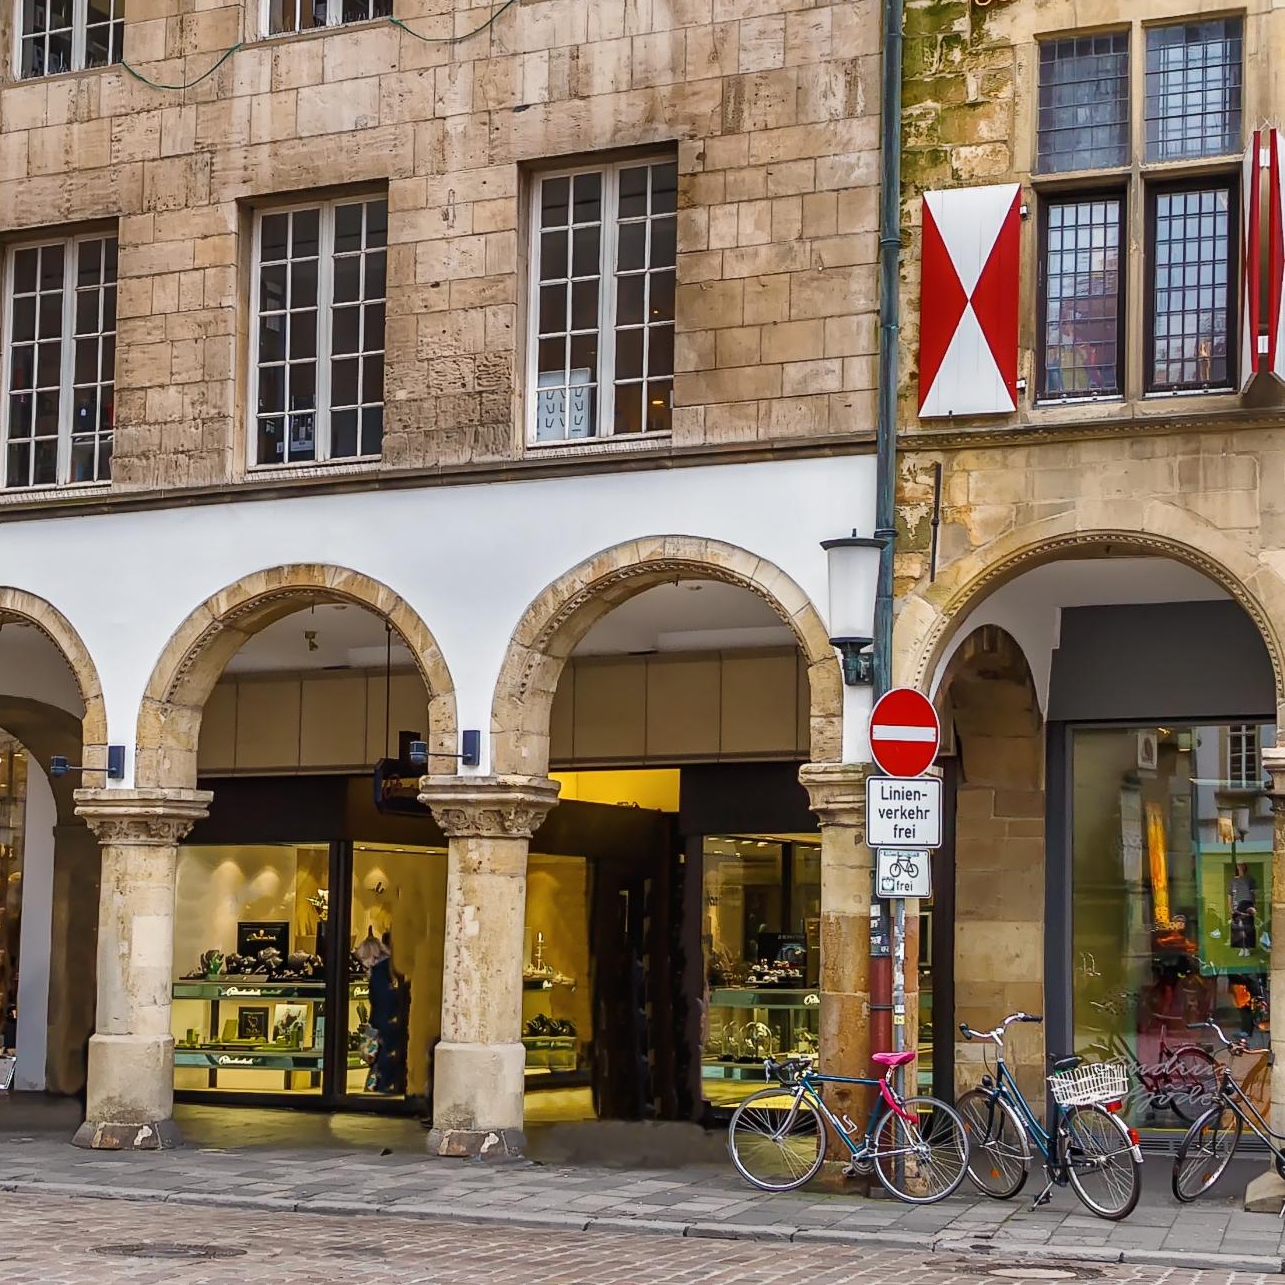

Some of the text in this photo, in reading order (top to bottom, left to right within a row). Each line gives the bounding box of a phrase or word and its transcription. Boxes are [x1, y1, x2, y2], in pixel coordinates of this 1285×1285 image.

[881, 785, 927, 801] Linien-
[879, 805, 930, 819] verkehr
[893, 824, 916, 838] frei
[896, 881, 913, 891] frei
